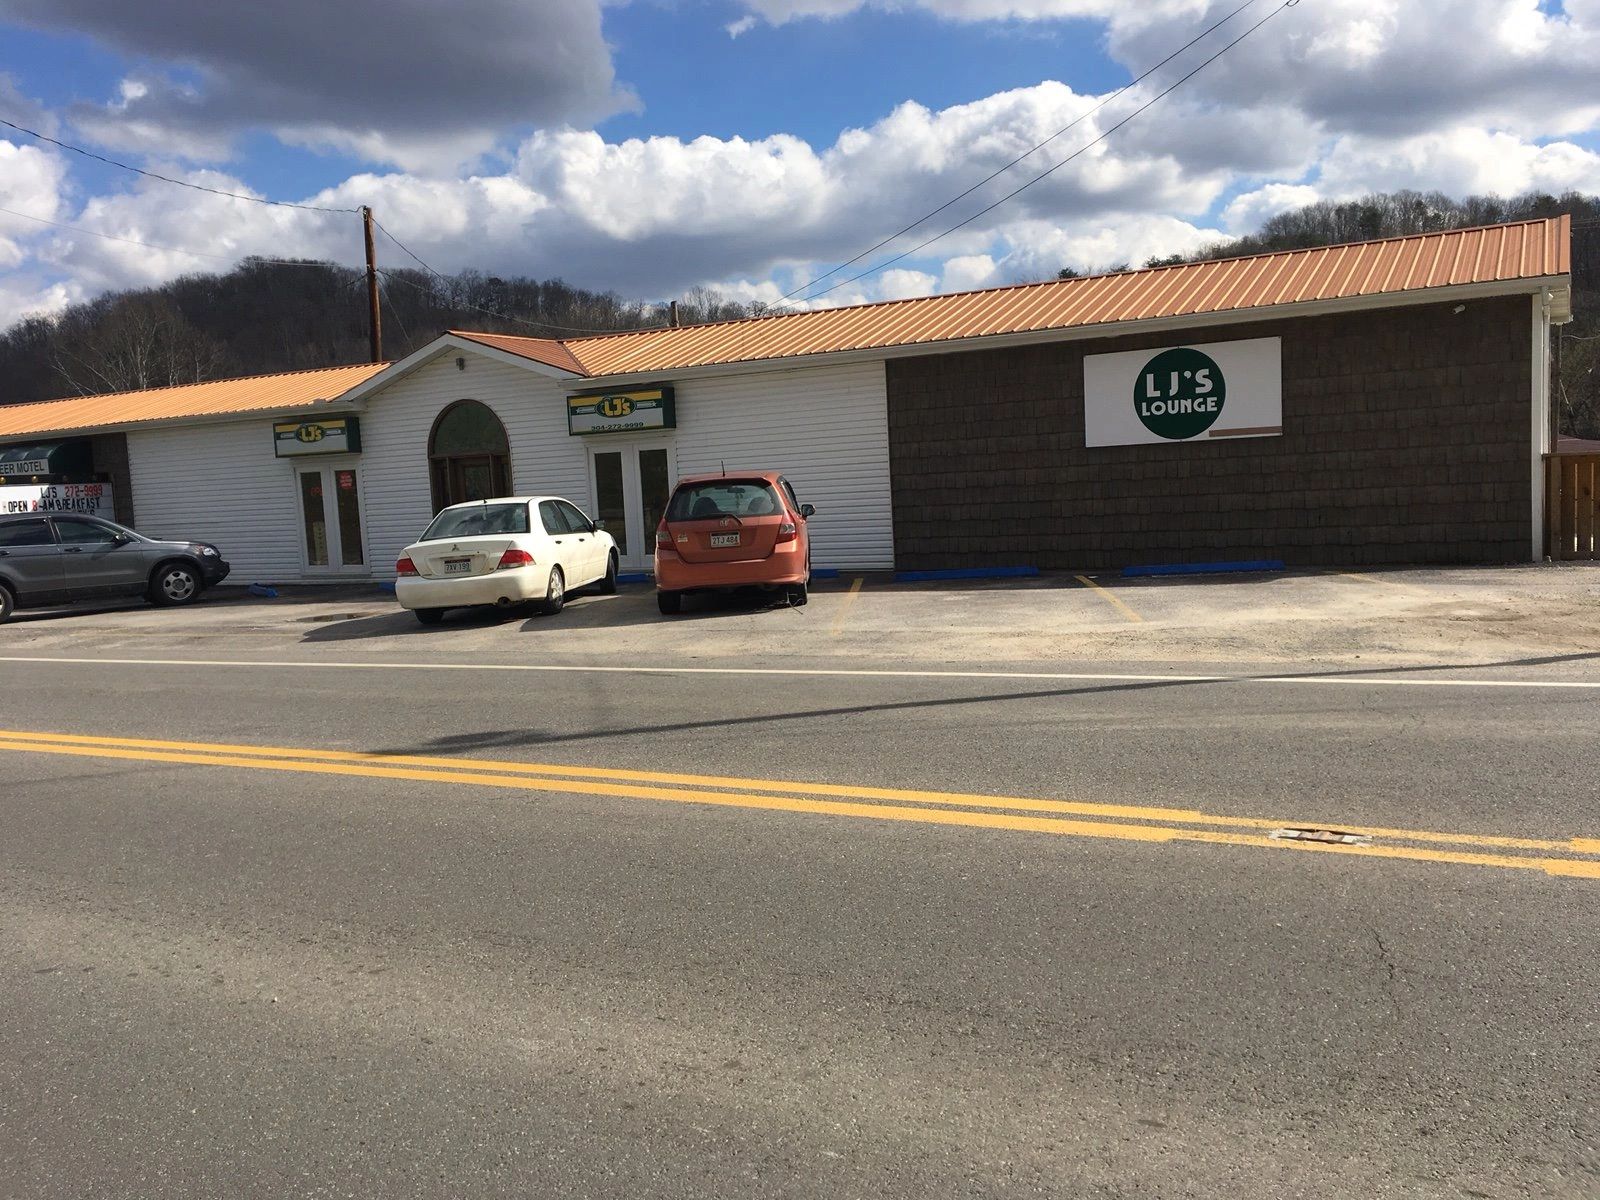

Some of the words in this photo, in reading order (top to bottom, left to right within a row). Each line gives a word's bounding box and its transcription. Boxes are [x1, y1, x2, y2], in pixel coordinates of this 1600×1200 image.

[1142, 396, 1218, 417] LOUNGE
[16, 460, 45, 473] MOTEL
[64, 484, 103, 498] 272-9999
[8, 500, 28, 513] OPEN
[56, 497, 100, 511] BREAKFAST
